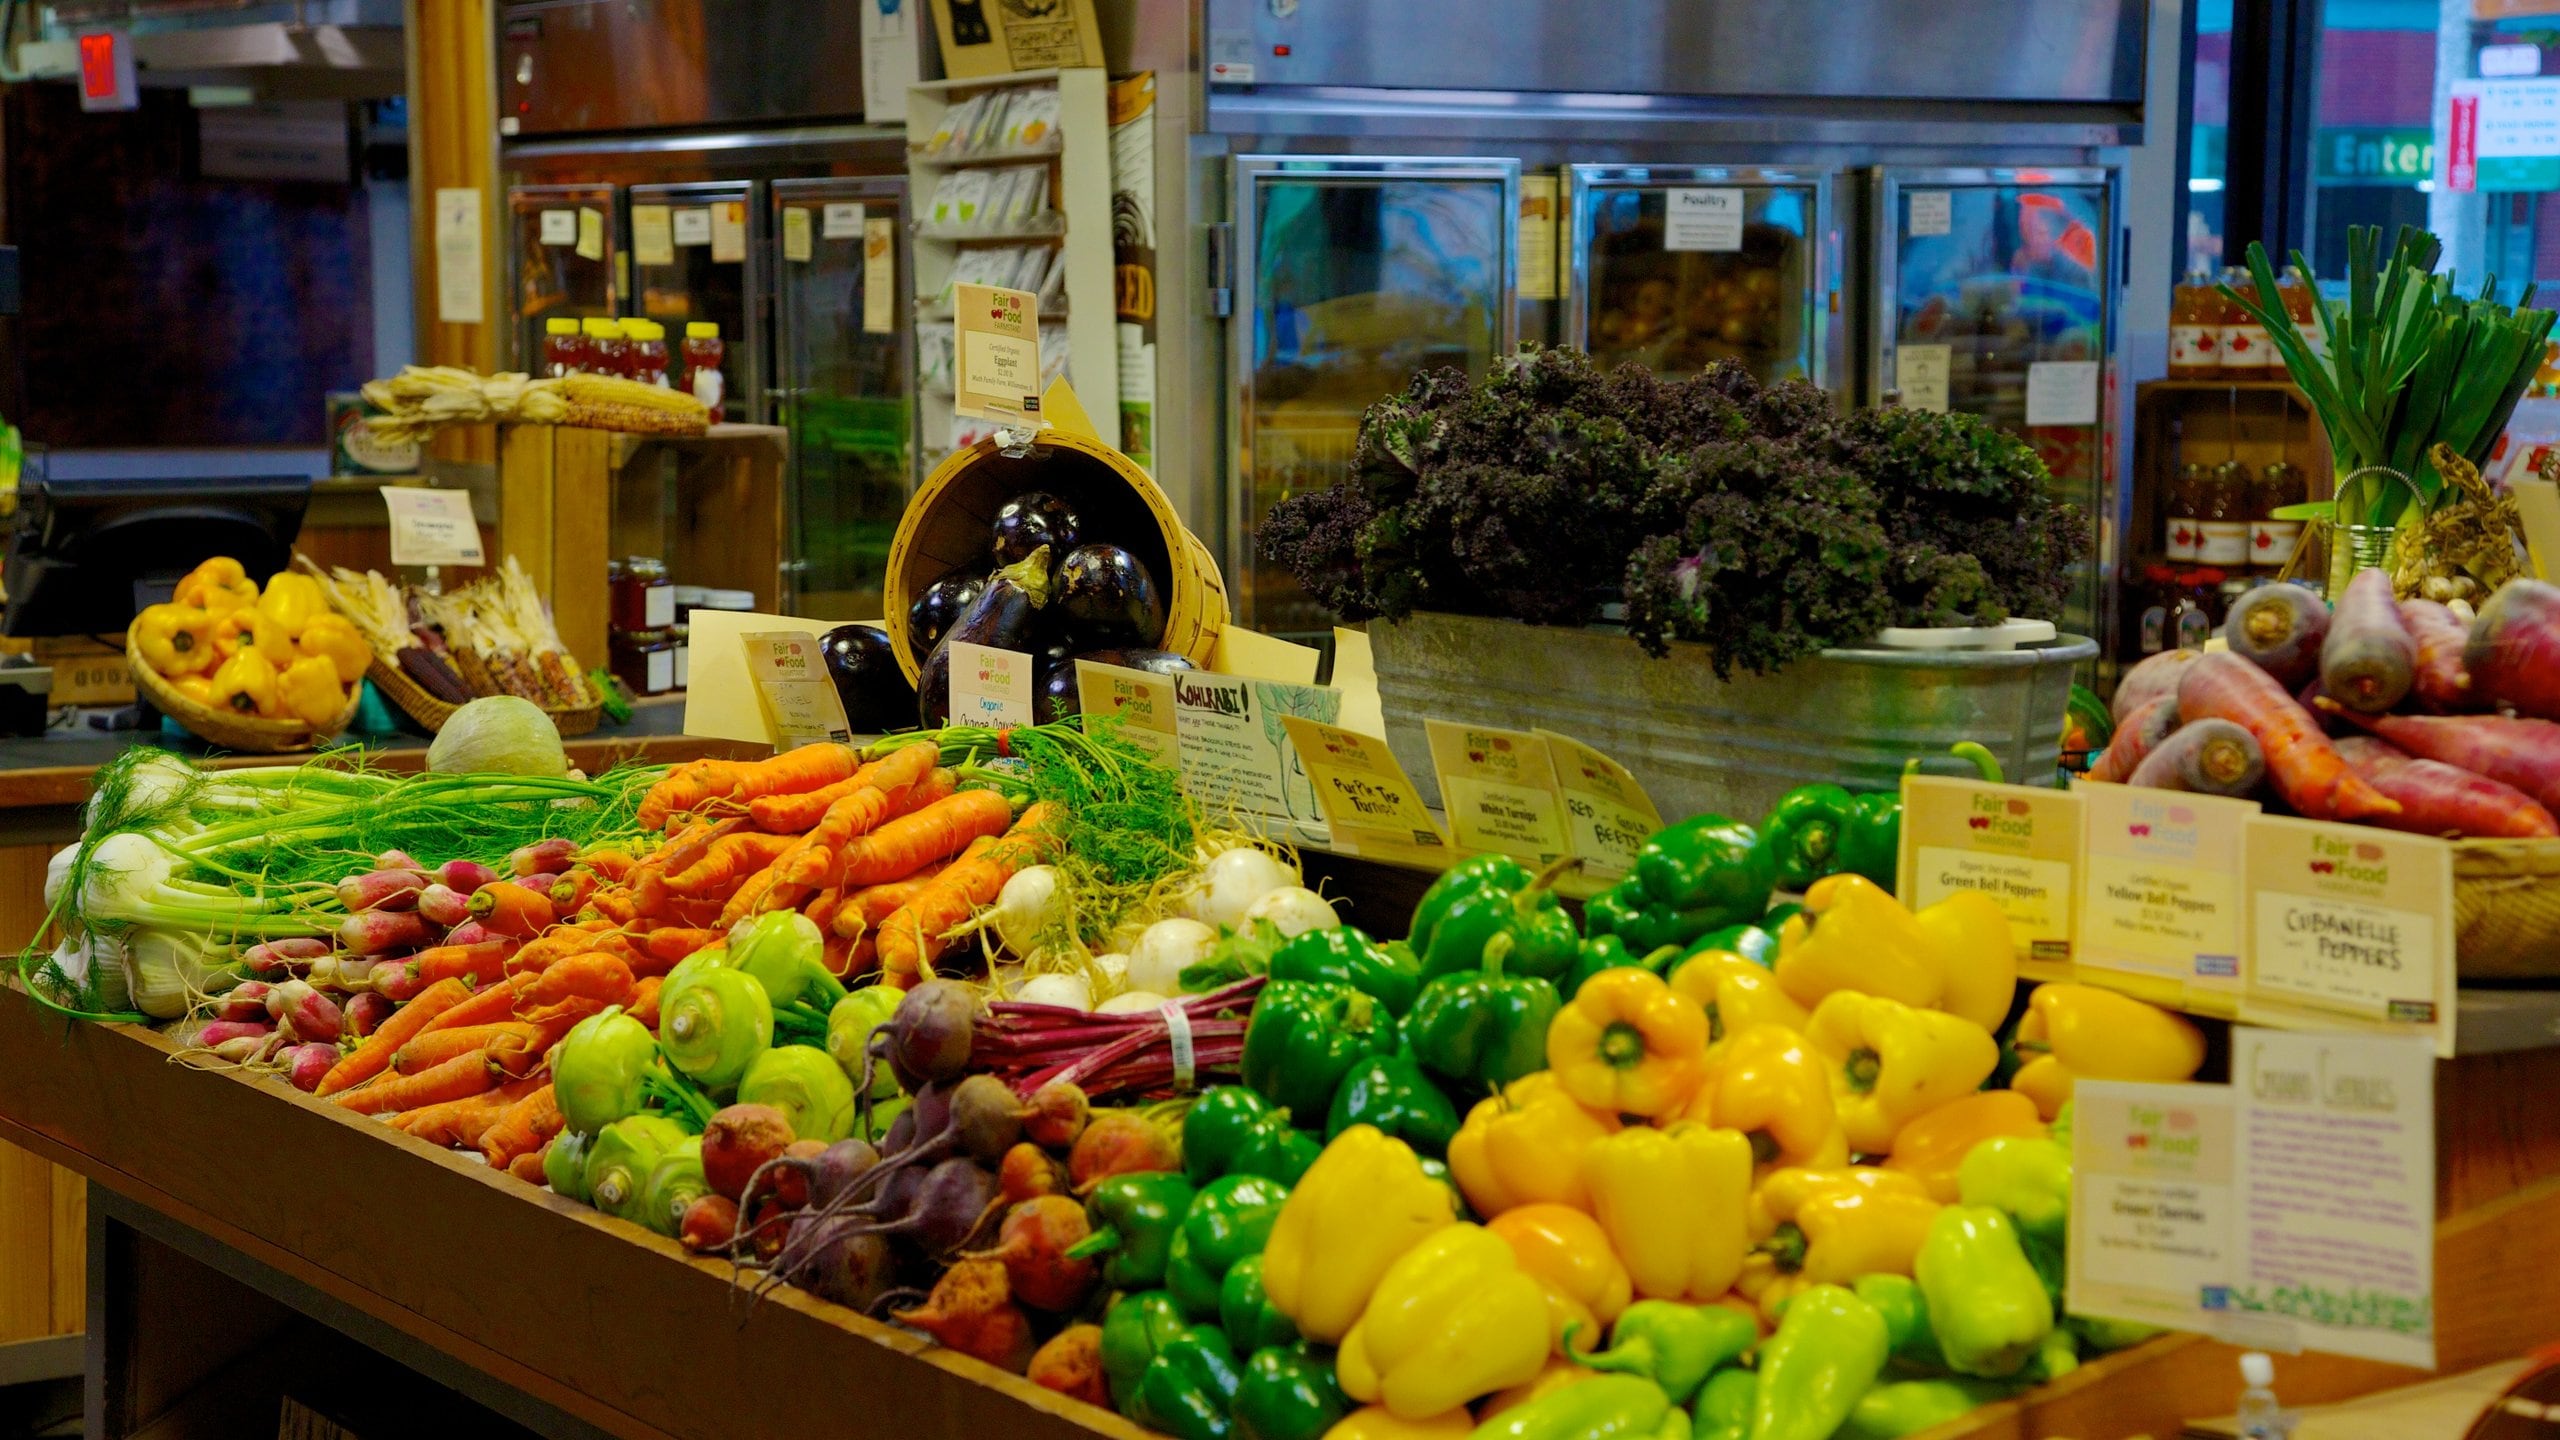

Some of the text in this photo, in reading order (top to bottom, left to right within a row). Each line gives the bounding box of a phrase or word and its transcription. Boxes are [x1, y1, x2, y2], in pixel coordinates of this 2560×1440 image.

[1682, 192, 1729, 208] Poultry
[993, 293, 1009, 307] Fair
[1003, 309, 1022, 324] Food
[989, 343, 1020, 356] Certified Organic
[994, 355, 1018, 368] Eggplant
[773, 643, 789, 655] Fair
[784, 656, 805, 668] Food
[980, 654, 995, 667] Fair
[990, 670, 1011, 685] Food
[1114, 680, 1132, 695] Fair
[980, 697, 1004, 716] Organic
[1127, 697, 1152, 713] Food
[1192, 718, 1201, 727] ARE
[1319, 728, 1341, 742] Fair
[1466, 732, 1491, 749] Fair
[1340, 747, 1369, 762] Food
[1485, 751, 1518, 768] Food
[1973, 793, 2004, 812] Fair
[2132, 799, 2165, 819] Fair
[1479, 802, 1537, 823] White Turnips
[1568, 798, 1649, 836] RED GOLD
[1992, 815, 2032, 836] Food
[1594, 823, 1642, 850] BEETS
[2154, 824, 2198, 846] Food
[2312, 834, 2352, 856] Fair
[2336, 860, 2388, 884] Food
[1940, 872, 2047, 899] Green Bell Peppers
[2107, 885, 2216, 914] Yellow Bell Peppers
[2287, 907, 2401, 946] CUBANELLE
[2318, 937, 2403, 972] PEPPERS
[2129, 1105, 2163, 1127] Fair
[2151, 1134, 2200, 1156] Food
